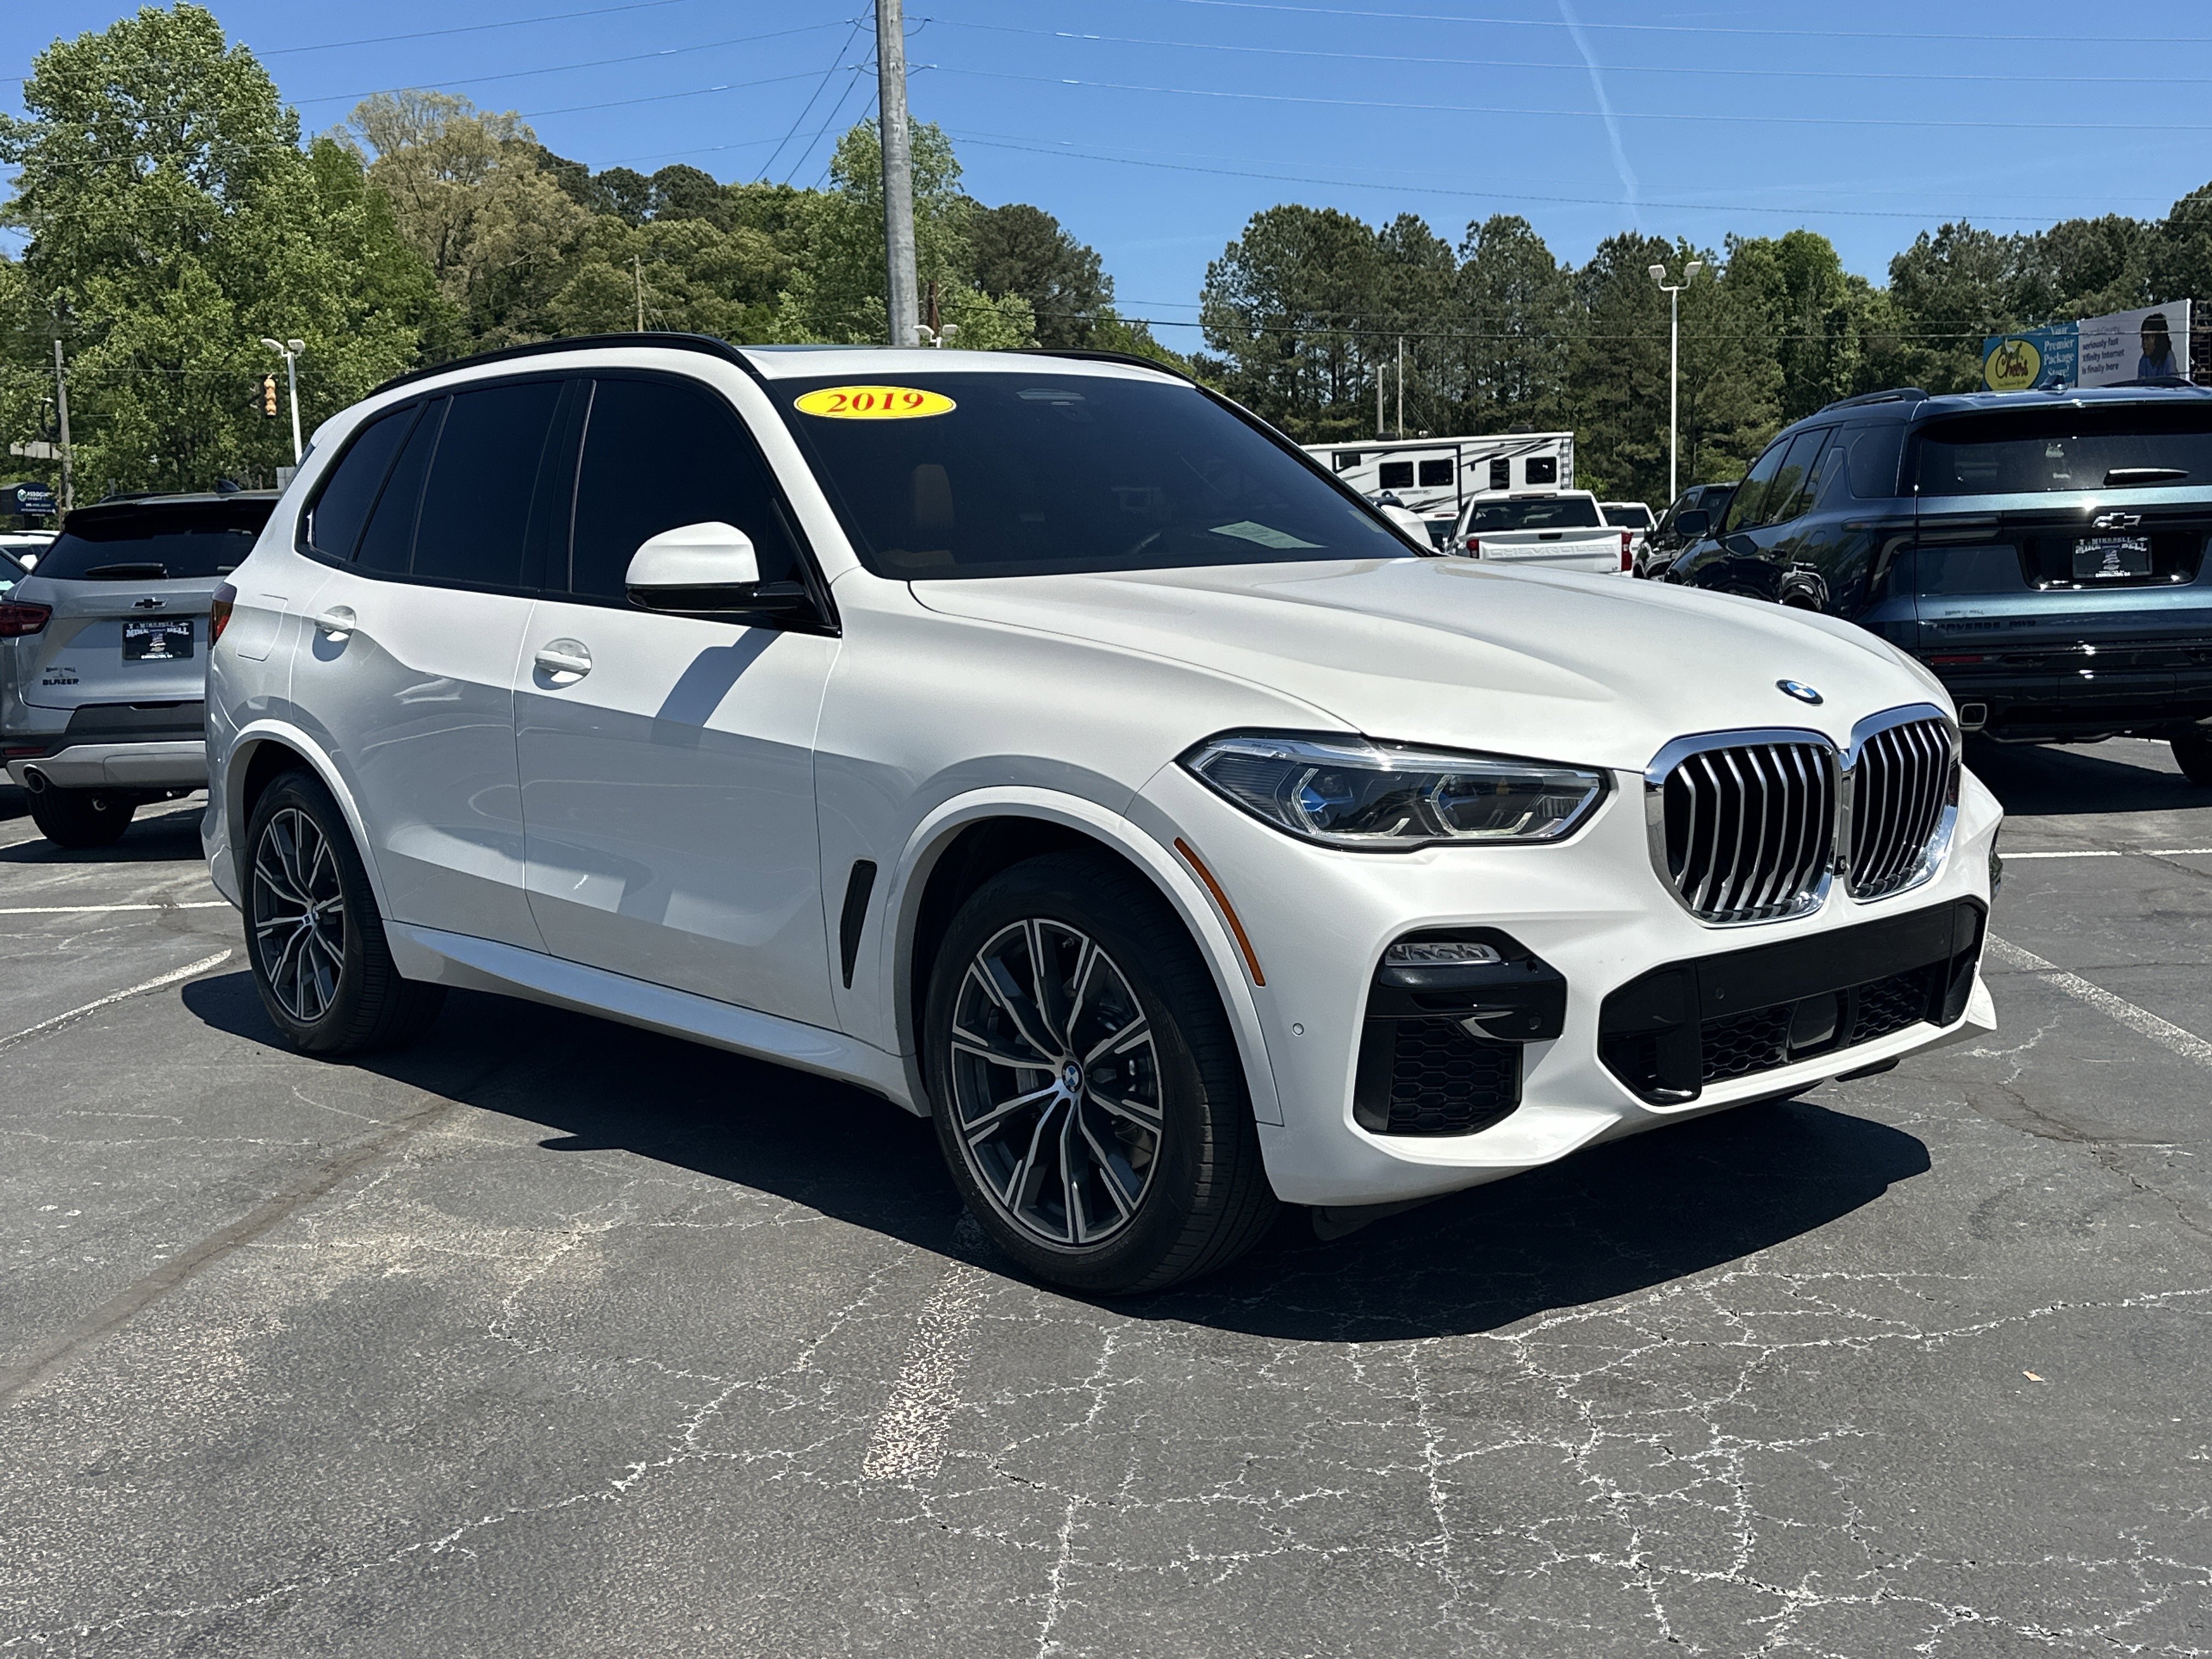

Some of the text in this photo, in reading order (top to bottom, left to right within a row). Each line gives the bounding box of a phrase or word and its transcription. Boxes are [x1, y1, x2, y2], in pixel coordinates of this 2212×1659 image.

[2044, 337, 2074, 352] Premier
[2083, 337, 2118, 350] seriously fast
[2044, 352, 2074, 365] Package
[2083, 352, 2100, 362] Xfinity
[2087, 364, 2104, 374] finally
[826, 393, 924, 413] 2019
[1489, 544, 1612, 558] CHEVROLET
